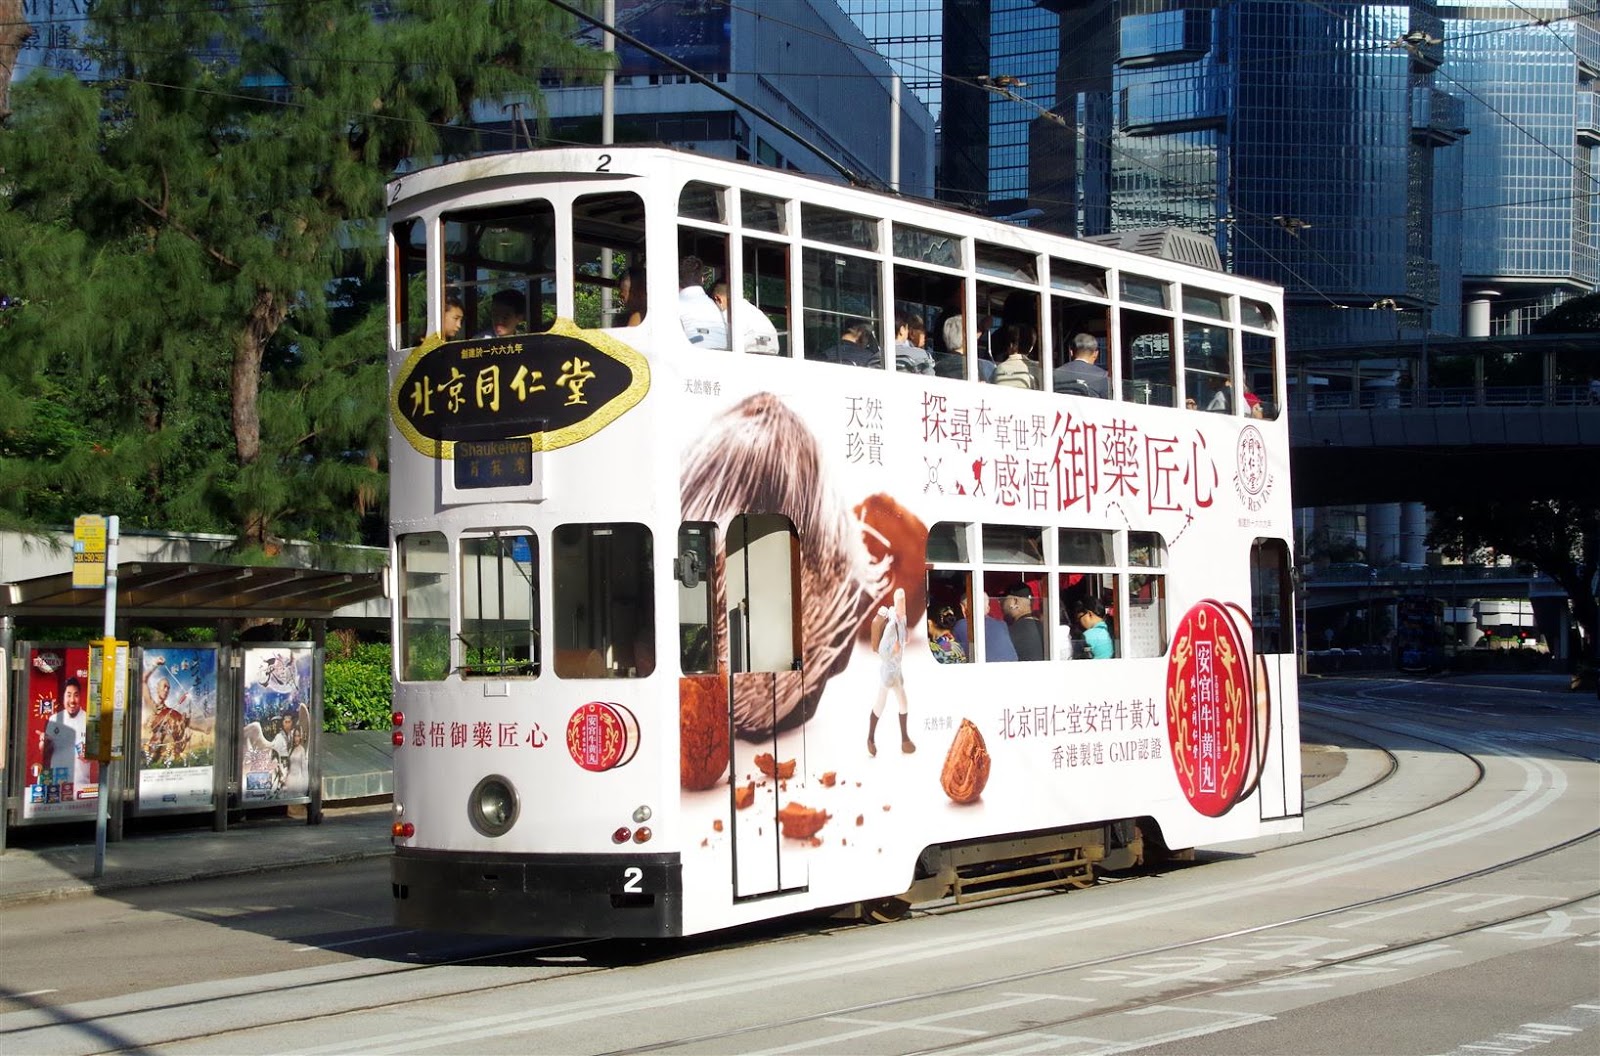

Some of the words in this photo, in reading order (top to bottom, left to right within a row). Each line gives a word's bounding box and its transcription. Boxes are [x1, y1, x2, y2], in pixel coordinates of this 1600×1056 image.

[596, 154, 612, 172] 2
[391, 182, 402, 203] 2
[410, 356, 596, 418] 北京同仁堂
[623, 867, 643, 893] 2
